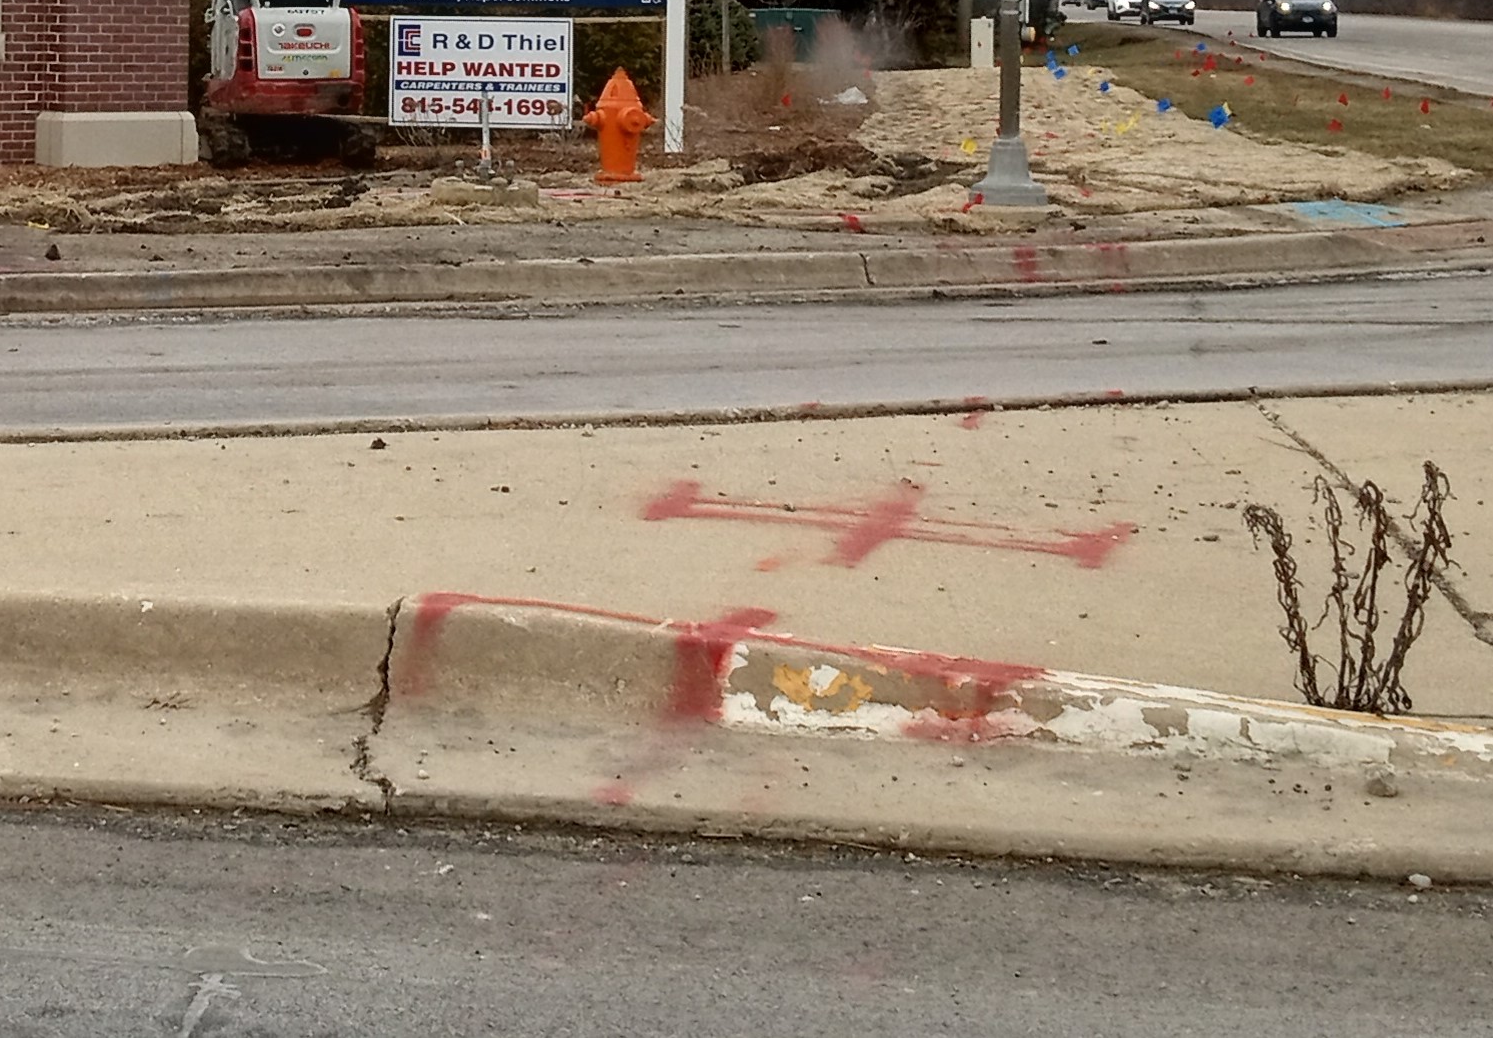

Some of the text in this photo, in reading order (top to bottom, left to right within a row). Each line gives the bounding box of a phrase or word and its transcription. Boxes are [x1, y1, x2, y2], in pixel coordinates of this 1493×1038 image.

[432, 33, 565, 51] R & D Thiel
[396, 61, 561, 78] HELP WANTED
[399, 80, 561, 92] CARPENTERS & TRAINEES
